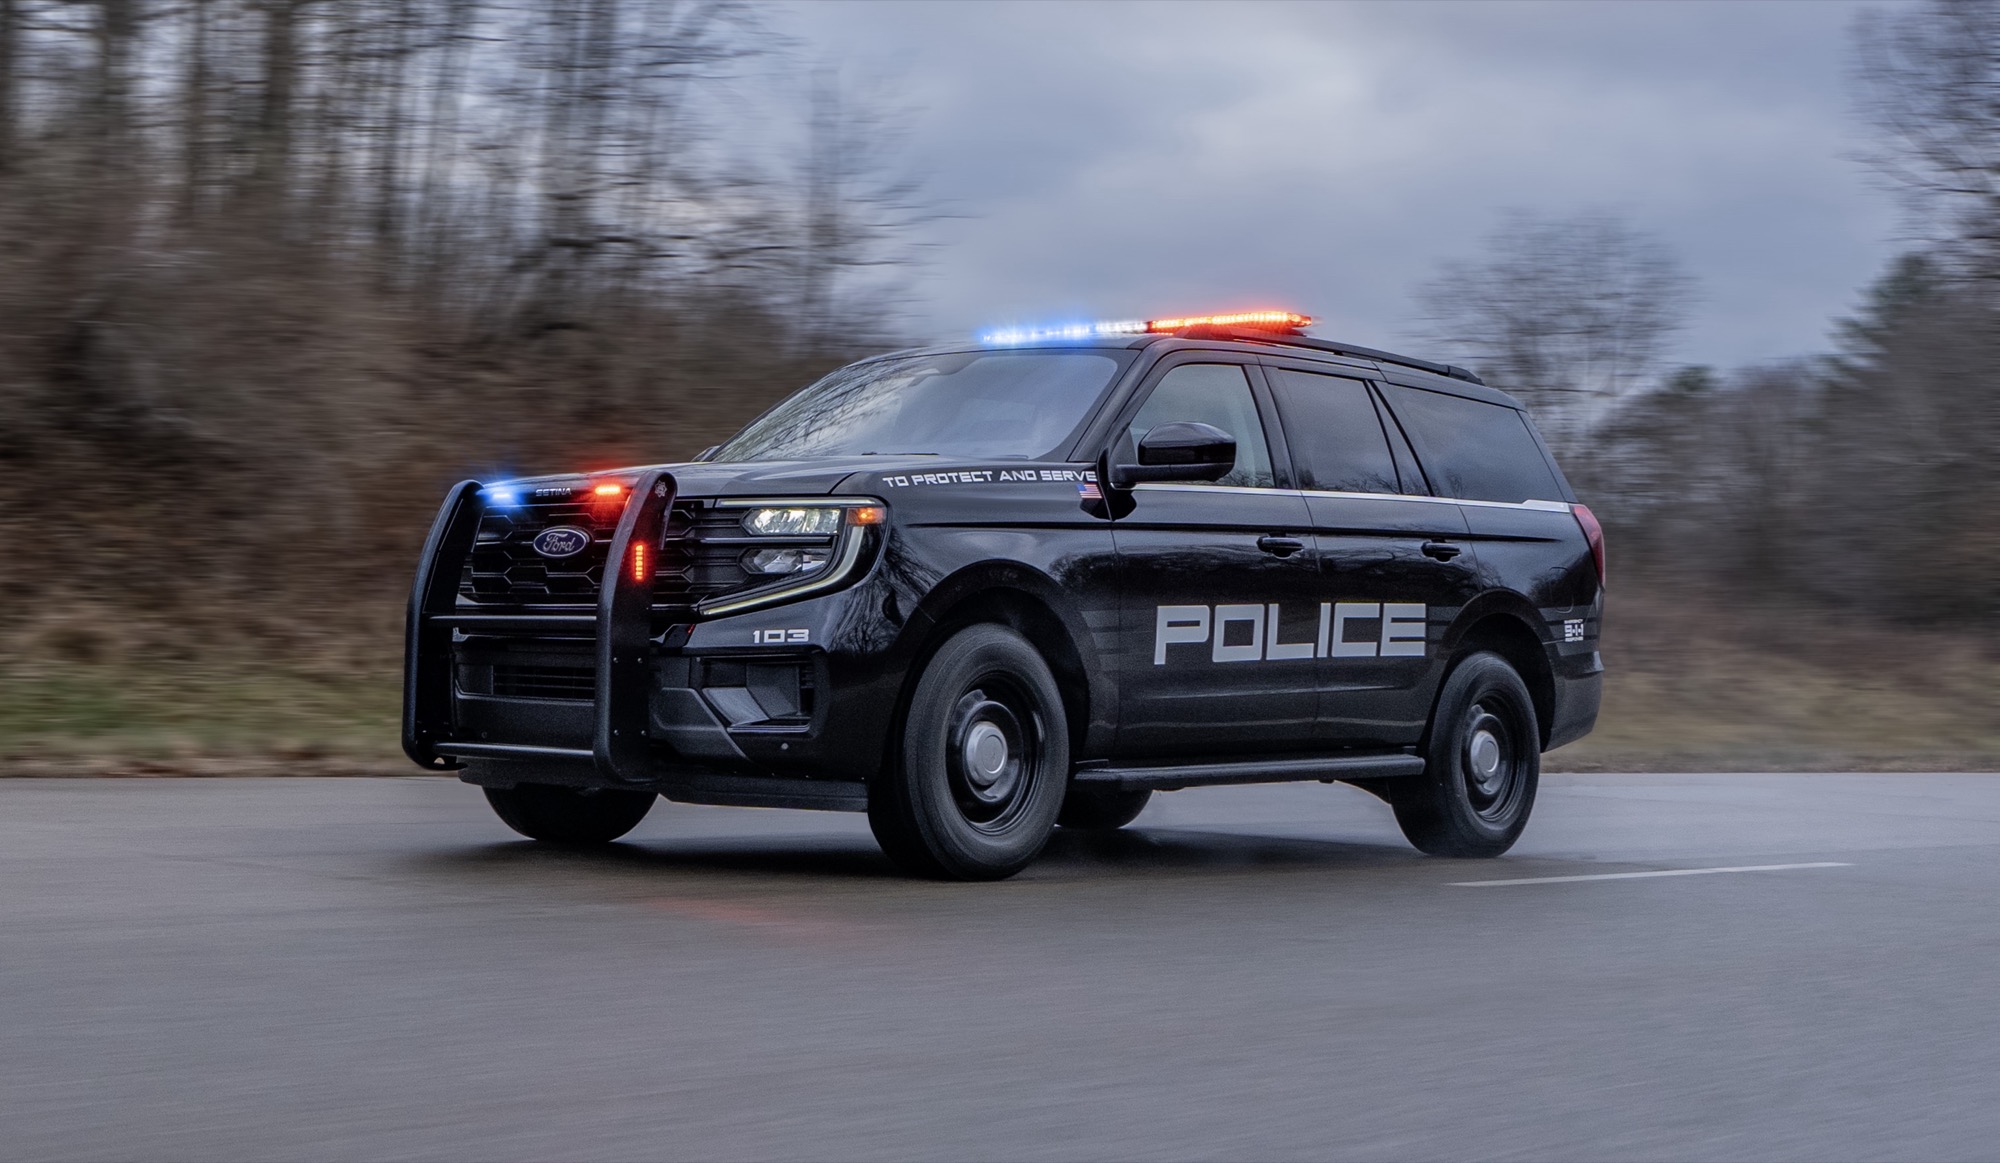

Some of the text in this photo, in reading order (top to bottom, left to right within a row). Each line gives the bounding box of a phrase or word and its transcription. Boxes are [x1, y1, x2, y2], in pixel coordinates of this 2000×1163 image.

[882, 470, 1098, 488] TO PROTECT AND SERVE
[535, 487, 572, 497] SETINA
[542, 532, 576, 552] Ford
[752, 628, 810, 644] 103
[1154, 602, 1427, 665] POLICE
